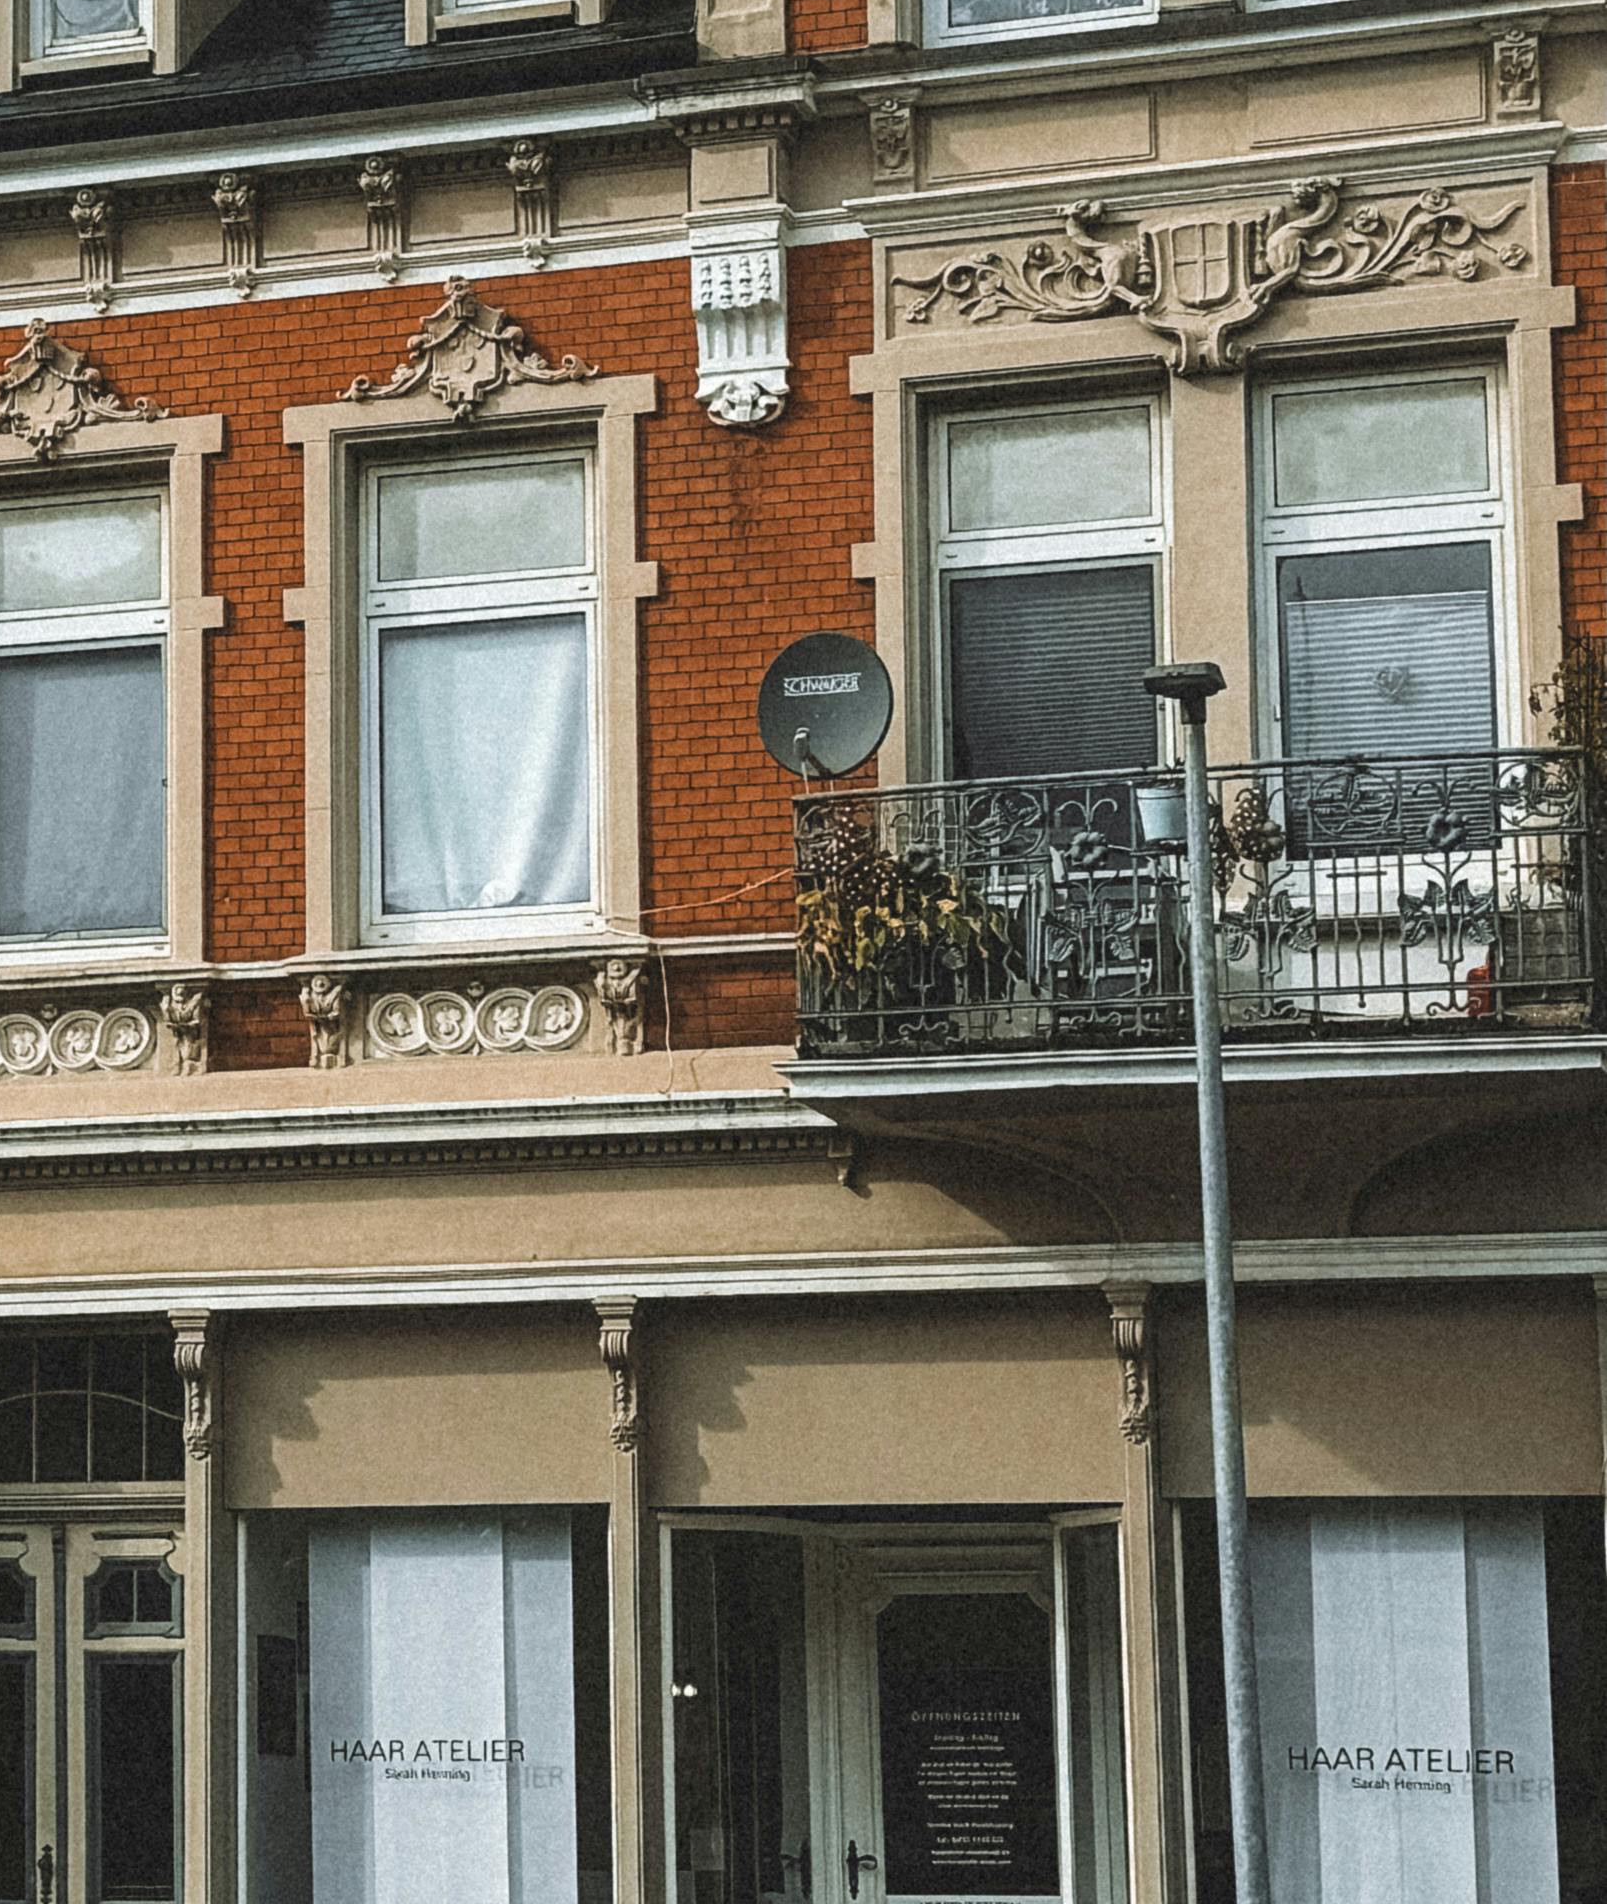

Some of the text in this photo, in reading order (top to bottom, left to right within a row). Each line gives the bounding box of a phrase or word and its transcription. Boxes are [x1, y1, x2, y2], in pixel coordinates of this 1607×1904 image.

[330, 1739, 525, 1762] HAAR ATELIER
[1288, 1746, 1515, 1774] HAAR ATELIER
[1351, 1777, 1451, 1794] Sarah Henning
